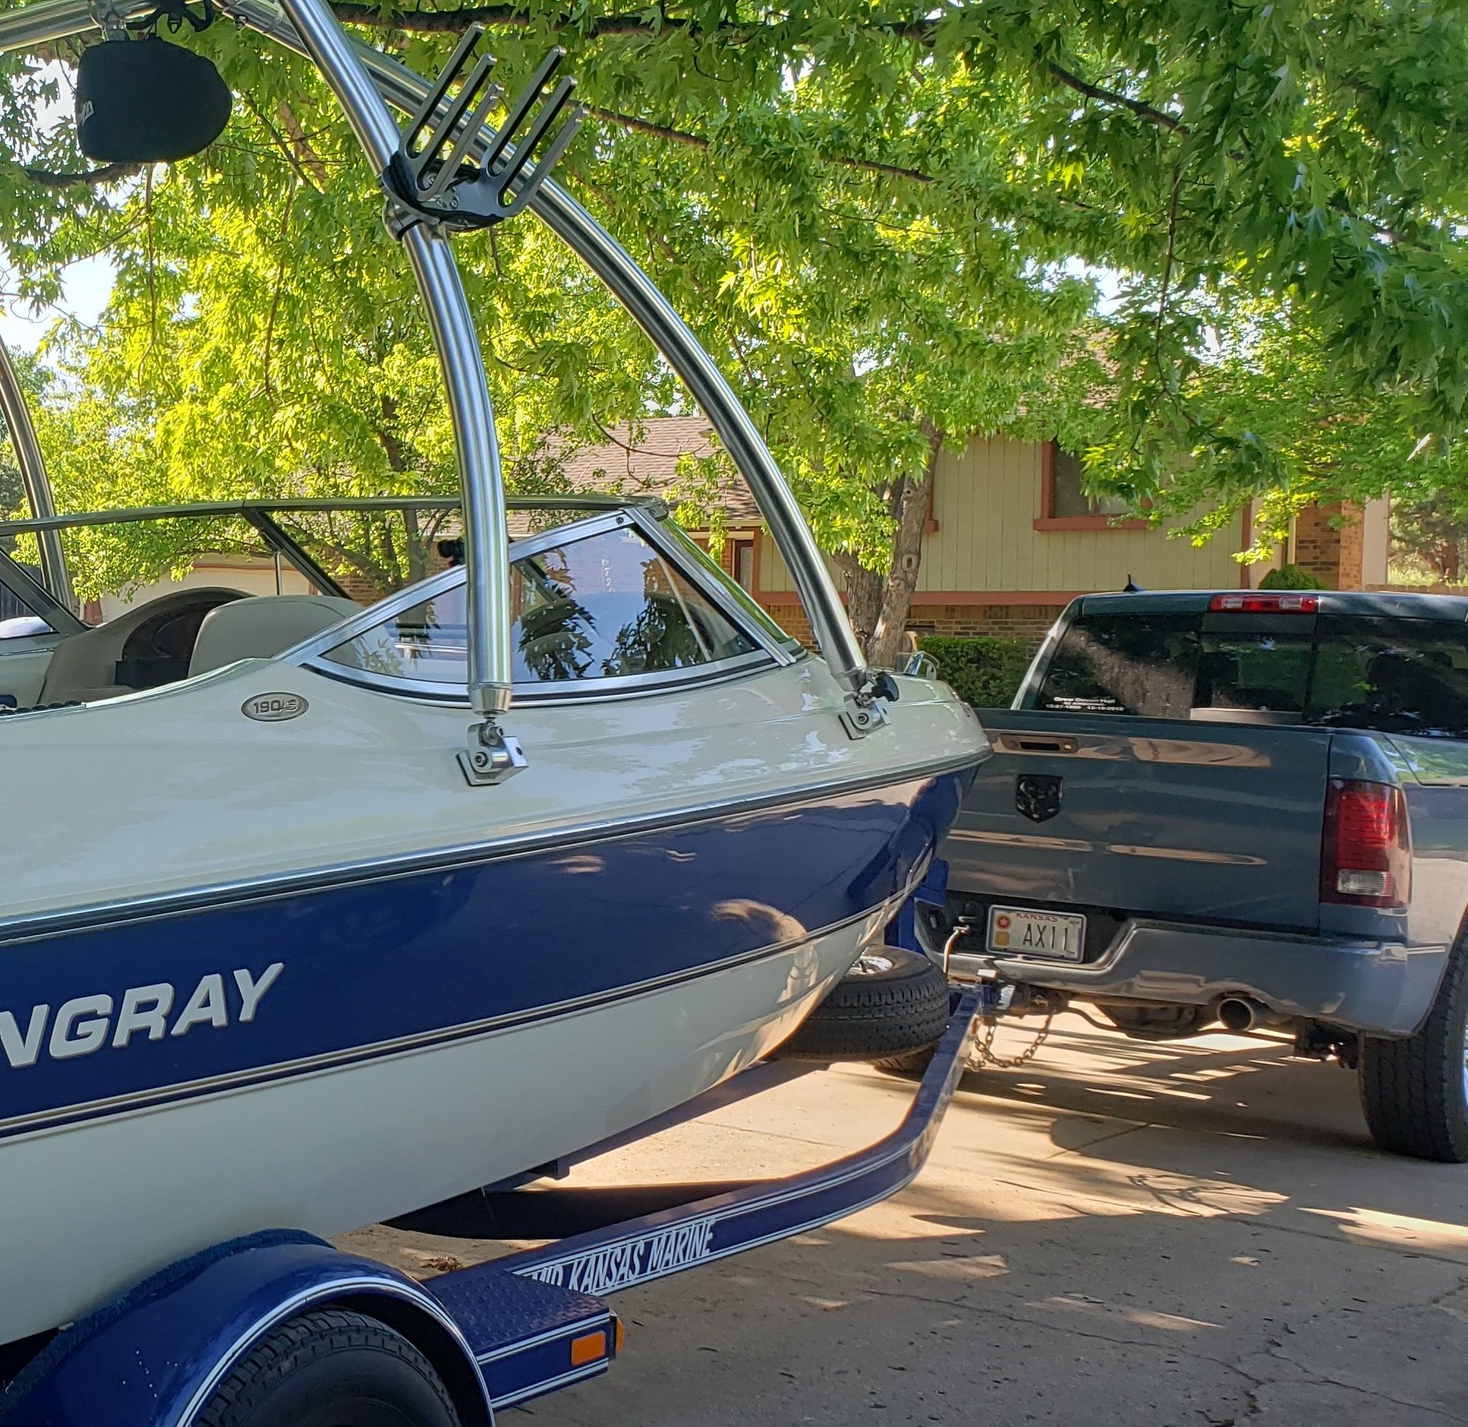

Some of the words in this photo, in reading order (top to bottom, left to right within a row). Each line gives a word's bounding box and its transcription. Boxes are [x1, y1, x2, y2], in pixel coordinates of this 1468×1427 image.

[1016, 912, 1059, 923] KANSAS
[568, 1240, 645, 1293] KANSAS
[646, 1217, 716, 1275] MARINE
